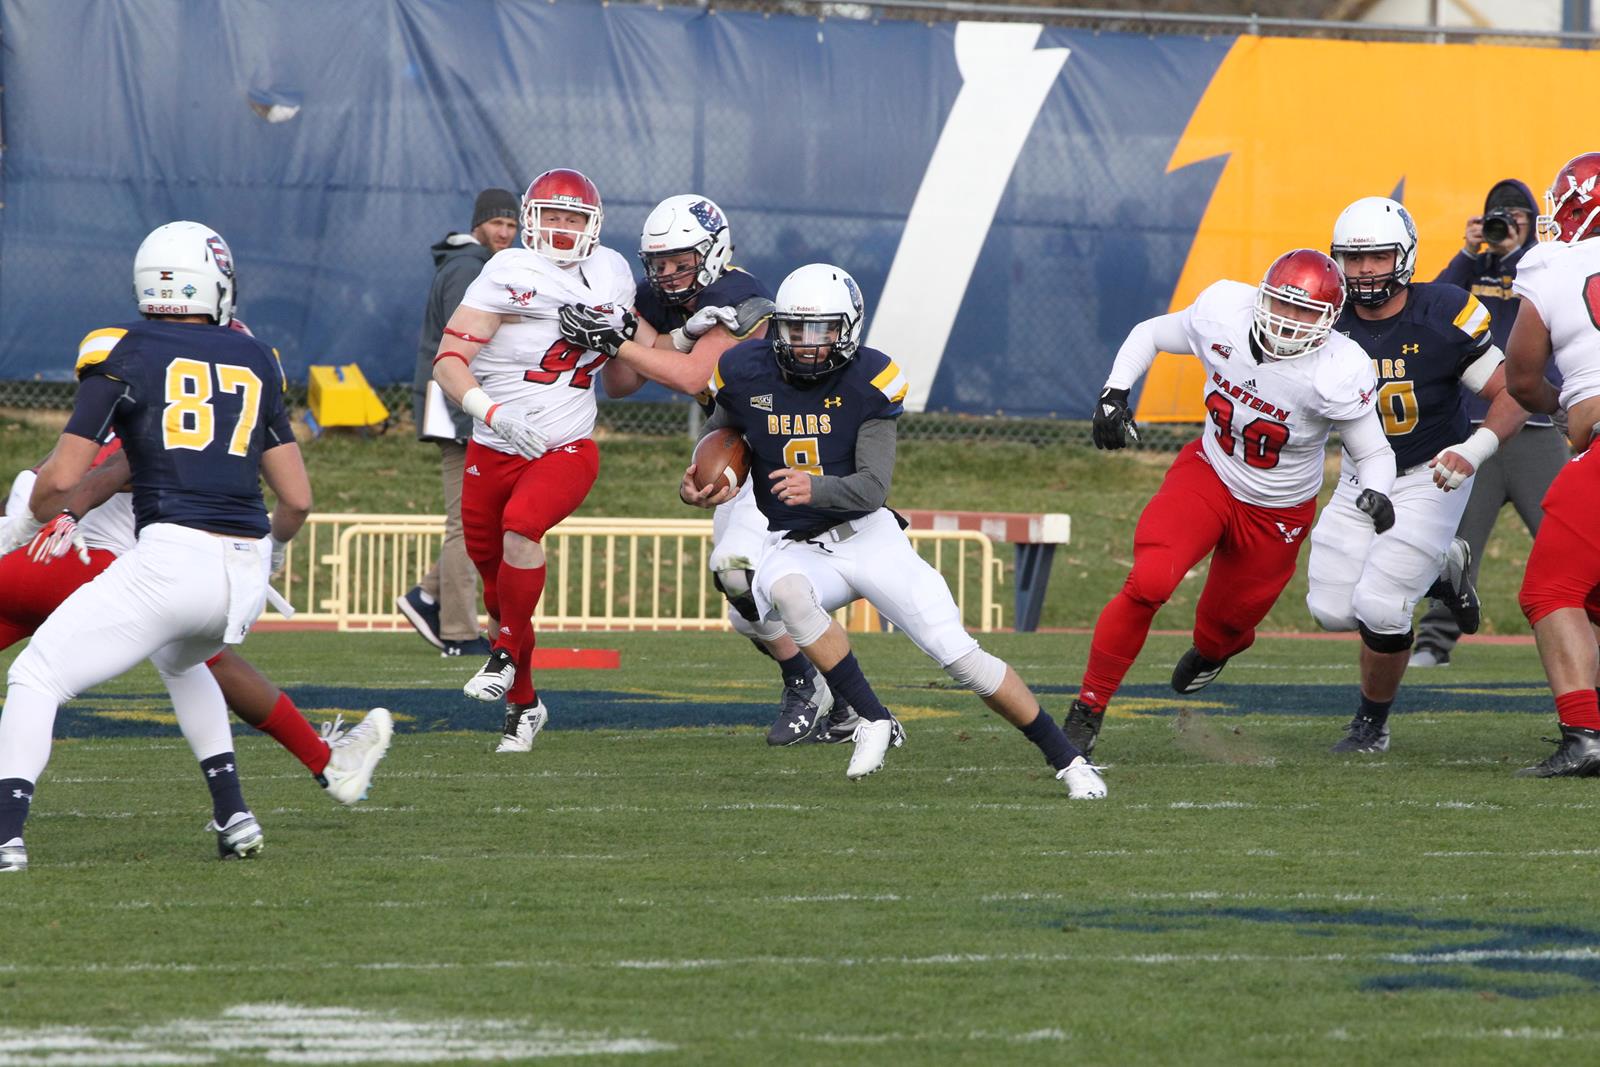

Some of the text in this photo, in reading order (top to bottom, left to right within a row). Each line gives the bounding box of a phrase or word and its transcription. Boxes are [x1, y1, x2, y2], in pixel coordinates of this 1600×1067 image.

[147, 304, 188, 313] Riddell
[161, 289, 173, 298] 87
[162, 357, 262, 457] 87
[1212, 371, 1291, 421] EASTERN
[767, 413, 832, 435] BEARS
[1205, 390, 1290, 469] 90
